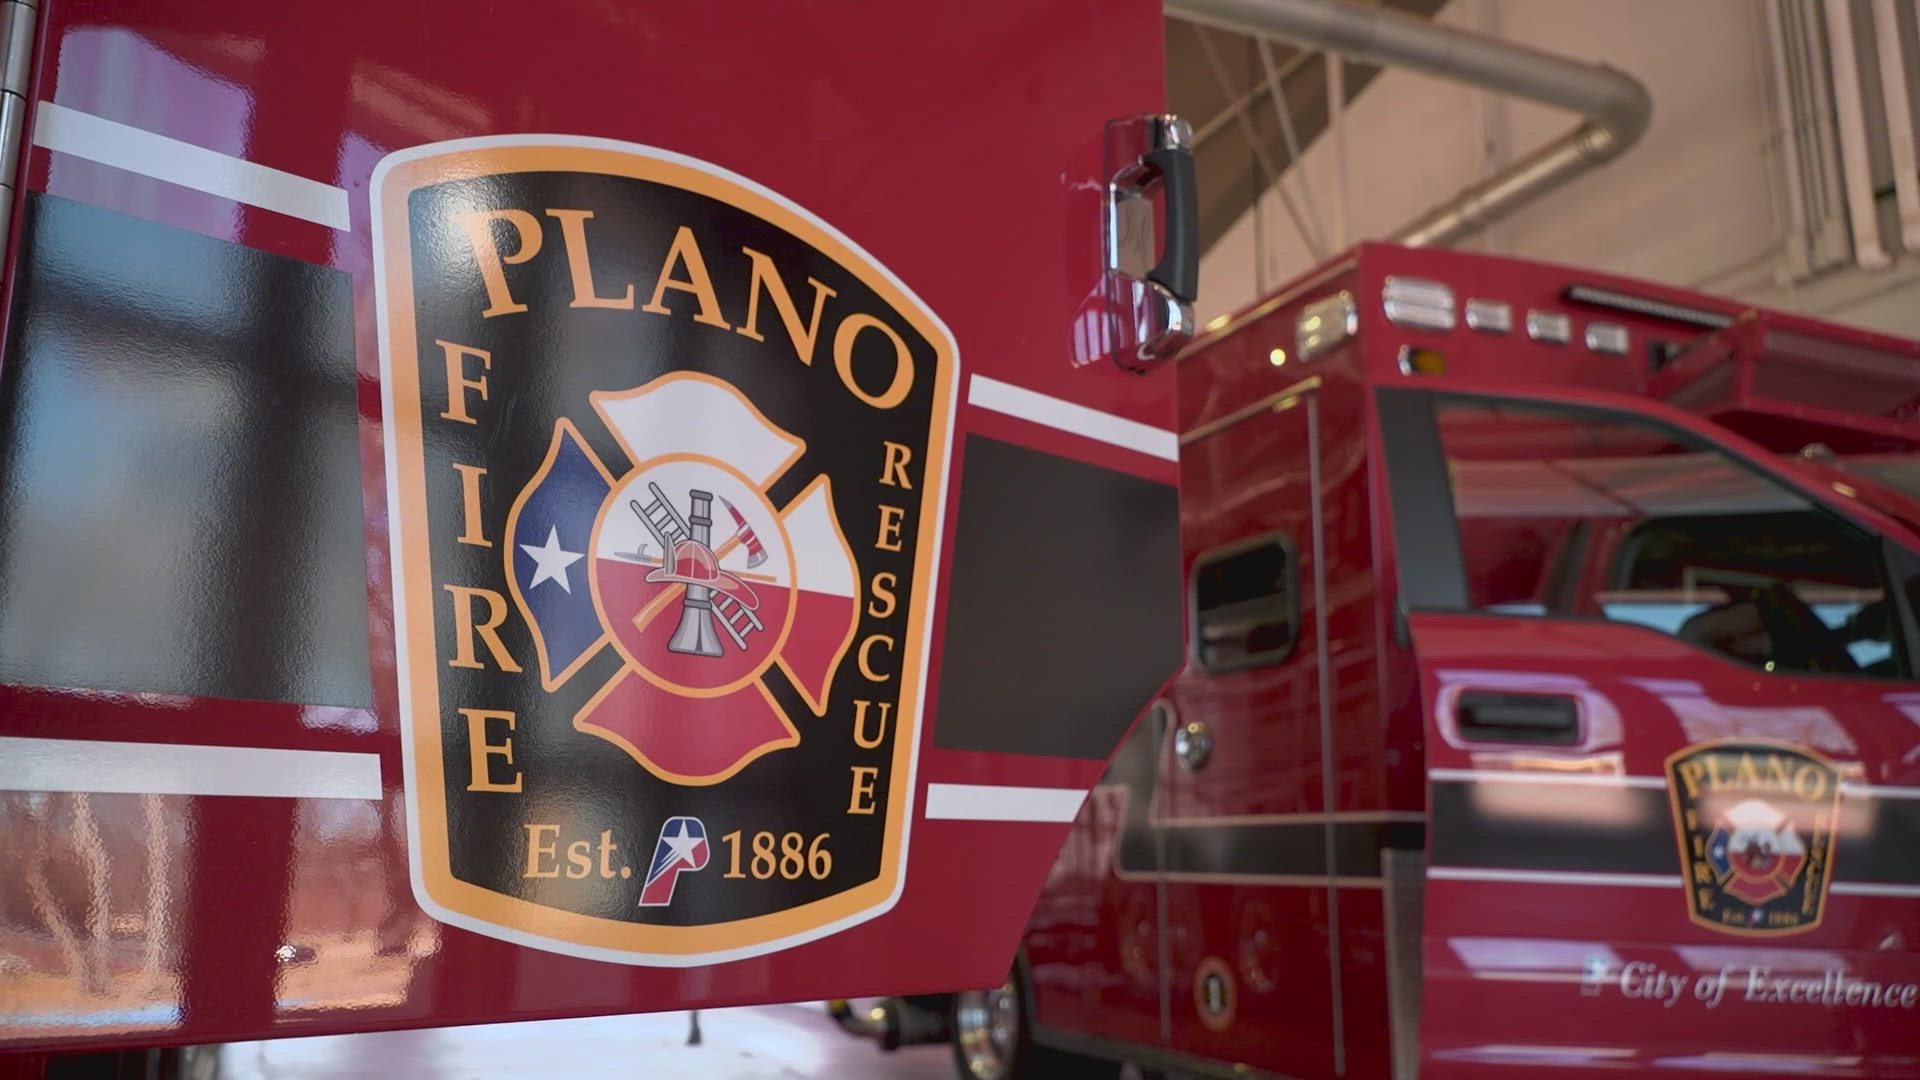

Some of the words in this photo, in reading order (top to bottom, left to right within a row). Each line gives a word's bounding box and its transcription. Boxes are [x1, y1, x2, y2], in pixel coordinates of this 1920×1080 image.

[450, 208, 914, 409] PLANO
[435, 339, 523, 794] FIRE
[846, 440, 912, 816] RESCUE
[1678, 752, 1827, 800] PLANO
[522, 823, 631, 880] Est.
[721, 831, 833, 881] 1886
[1619, 960, 1689, 1008] City
[1694, 963, 1737, 1009] of
[1744, 965, 1919, 1008] Excellence
